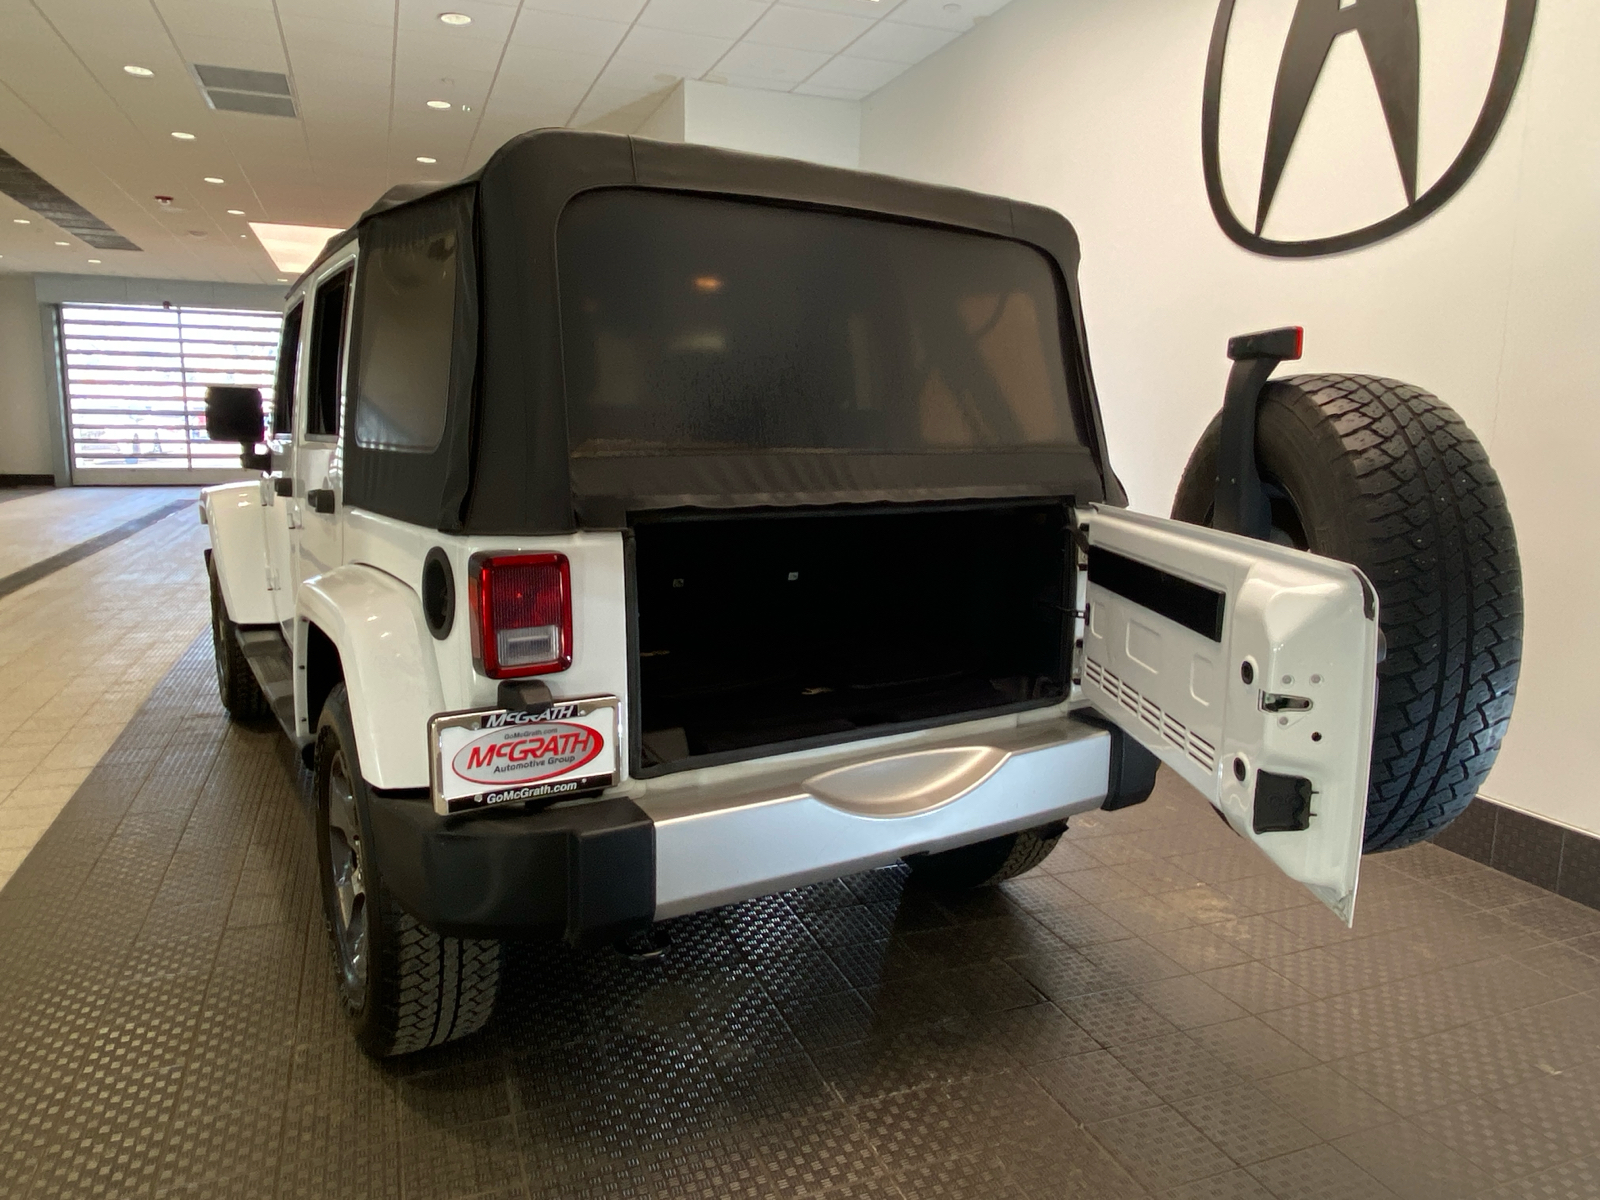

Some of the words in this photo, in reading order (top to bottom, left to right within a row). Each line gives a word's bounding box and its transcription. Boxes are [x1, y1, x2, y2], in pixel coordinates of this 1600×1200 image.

[466, 731, 592, 769] McGRATH
[493, 759, 546, 774] Automotive
[547, 755, 576, 767] Group
[486, 782, 578, 804] GoMcGrath.com
